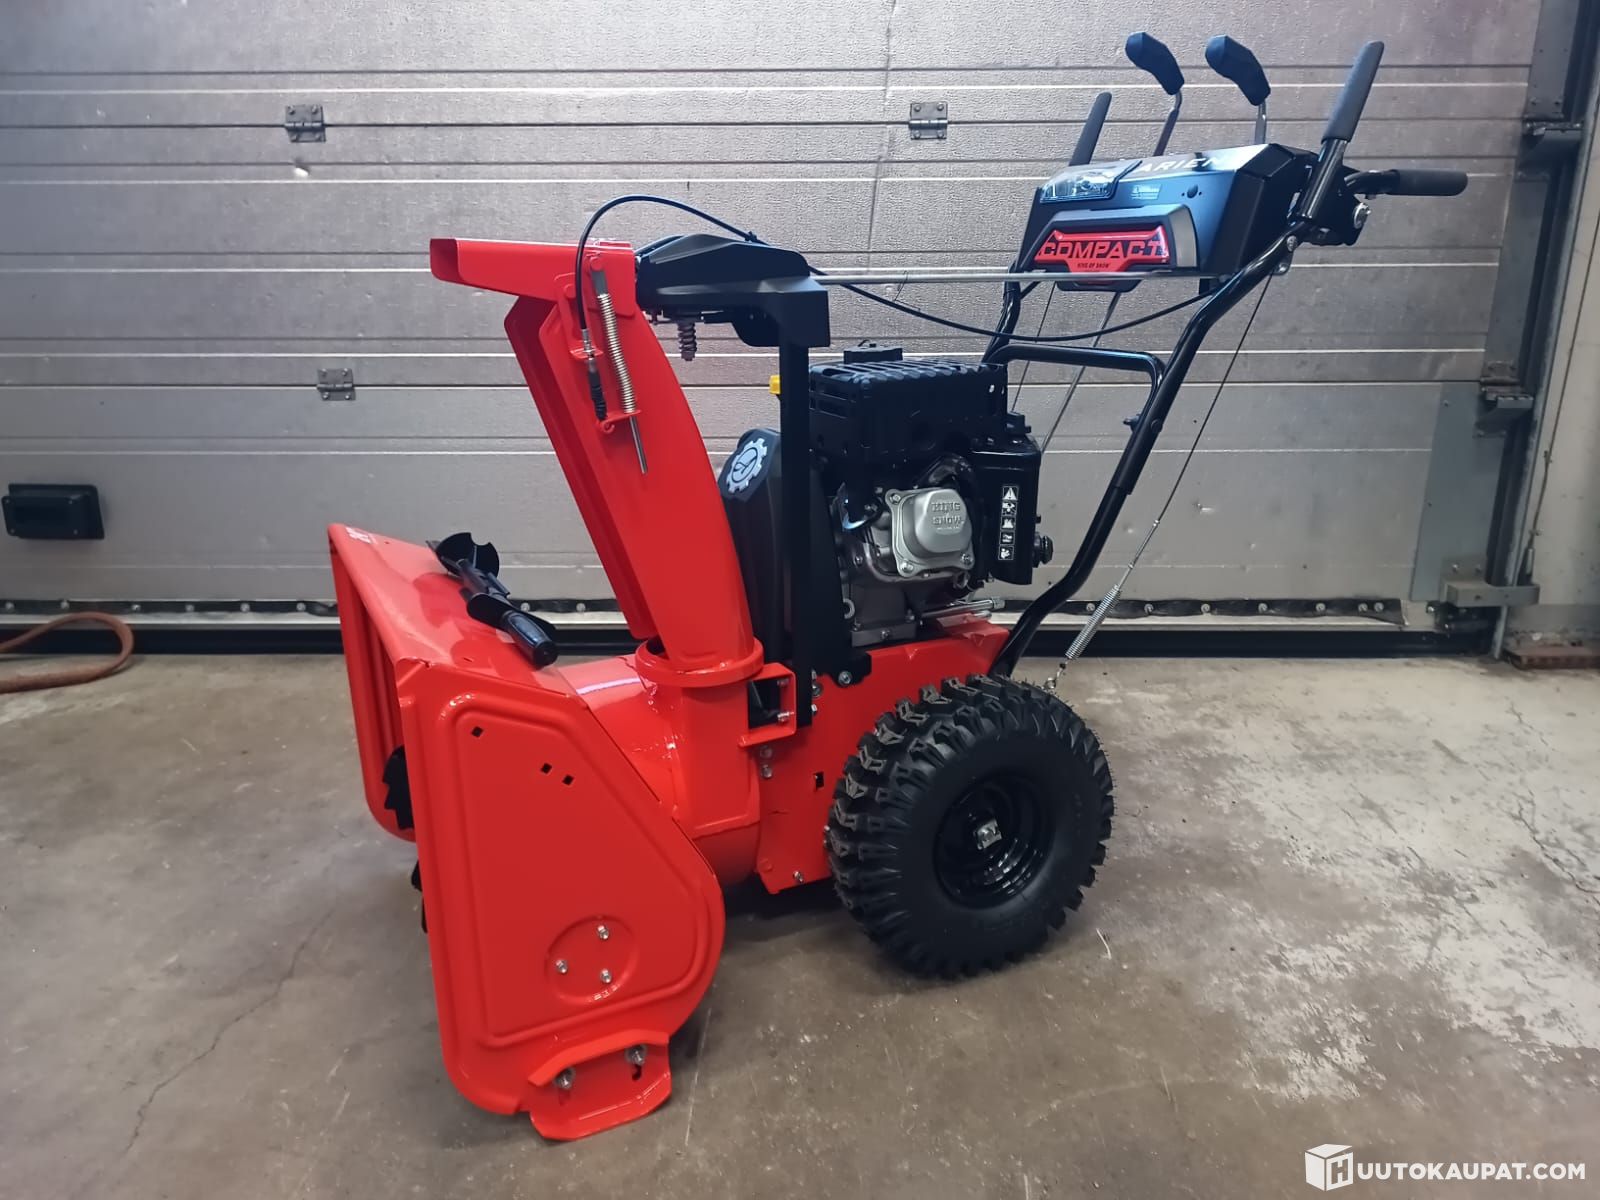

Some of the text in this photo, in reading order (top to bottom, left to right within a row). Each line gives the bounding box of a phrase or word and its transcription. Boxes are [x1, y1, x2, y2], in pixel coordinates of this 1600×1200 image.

[1139, 157, 1221, 173] ARIEN
[1040, 239, 1163, 259] COMPACT
[931, 501, 960, 512] KING
[931, 515, 961, 526] SNOW
